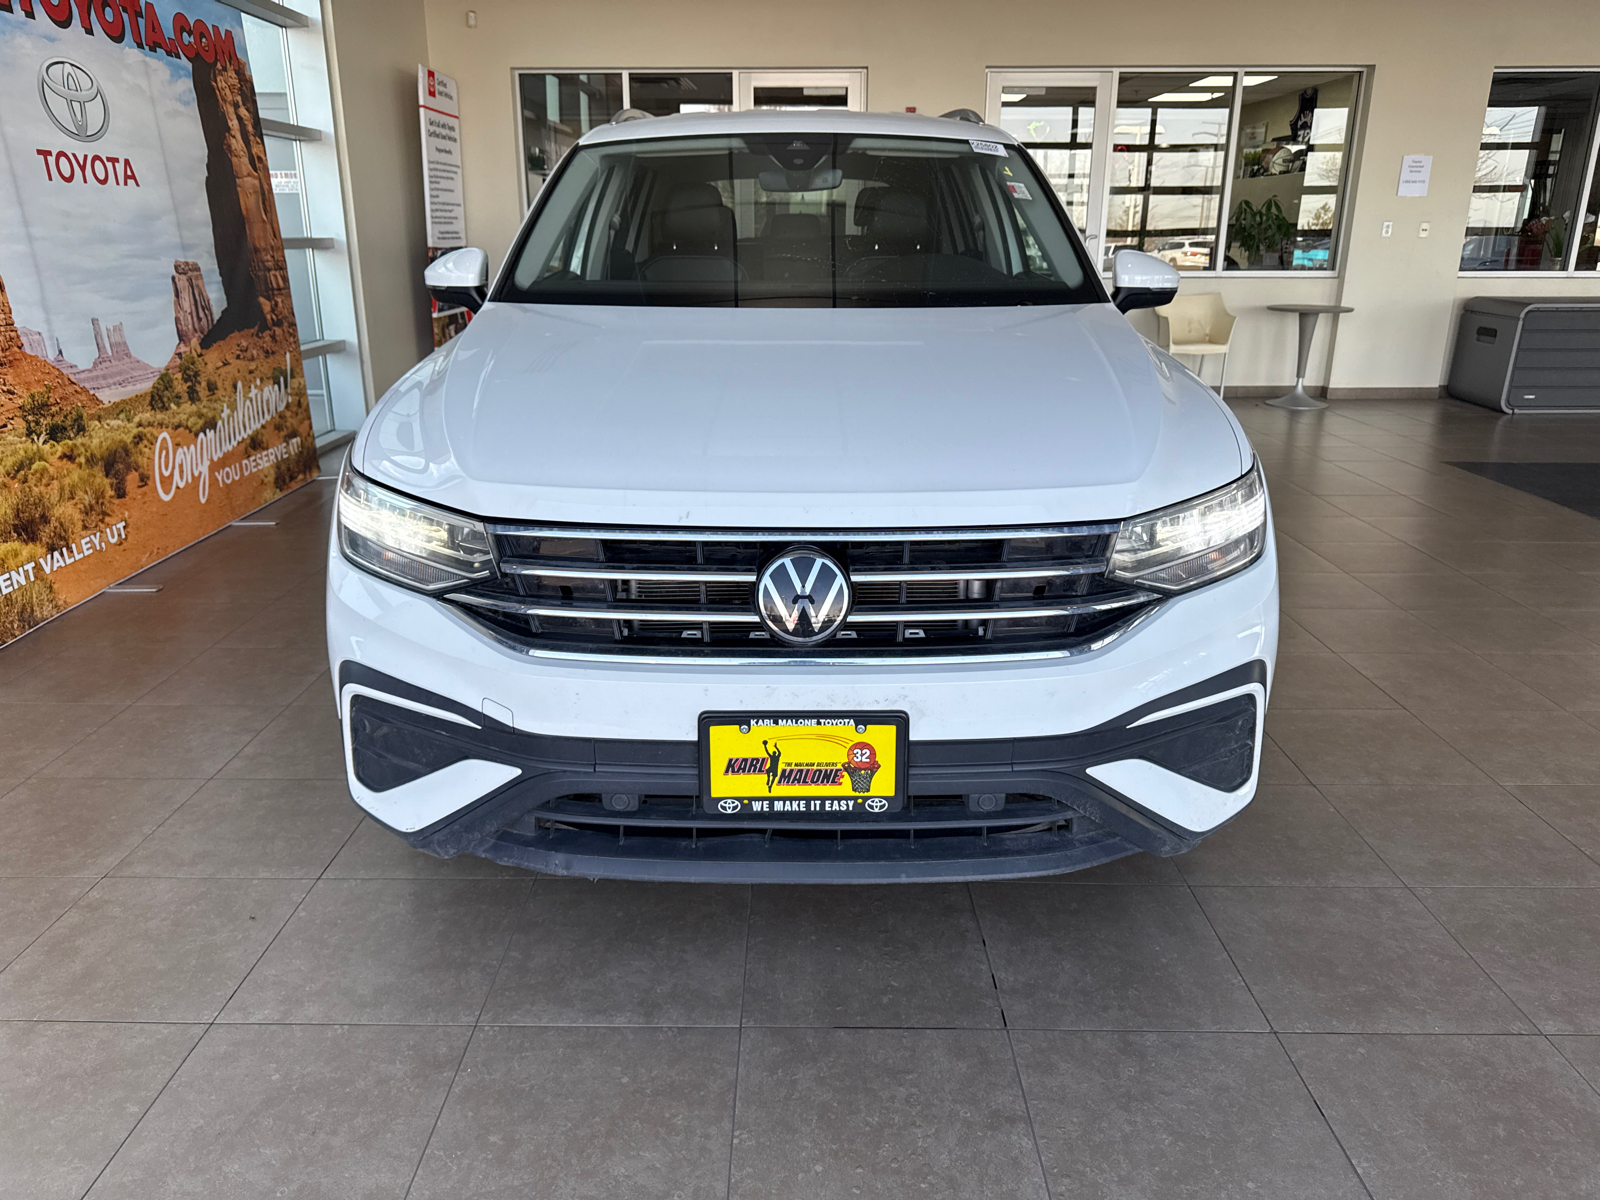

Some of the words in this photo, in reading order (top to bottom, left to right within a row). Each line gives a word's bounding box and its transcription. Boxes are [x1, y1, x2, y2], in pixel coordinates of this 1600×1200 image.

[0, 0, 240, 71] YOTA.COM
[36, 148, 140, 188] TOYOTA
[154, 352, 292, 504] Congratulations!
[215, 462, 240, 488] YOU
[242, 442, 289, 476] DESERVE
[288, 436, 302, 456] IT!
[0, 561, 36, 596] ENT
[38, 531, 106, 575] VALLEY,
[106, 520, 126, 544] UT
[750, 719, 775, 727] KARL
[778, 719, 818, 727] MALONE
[819, 719, 855, 727] TOYOTA
[723, 757, 769, 775] KARL
[853, 748, 870, 762] 32
[776, 768, 844, 786] MALONE
[752, 800, 770, 812] WE
[774, 800, 806, 811] MAKE
[810, 800, 821, 811] IT
[825, 800, 854, 811] EASY
